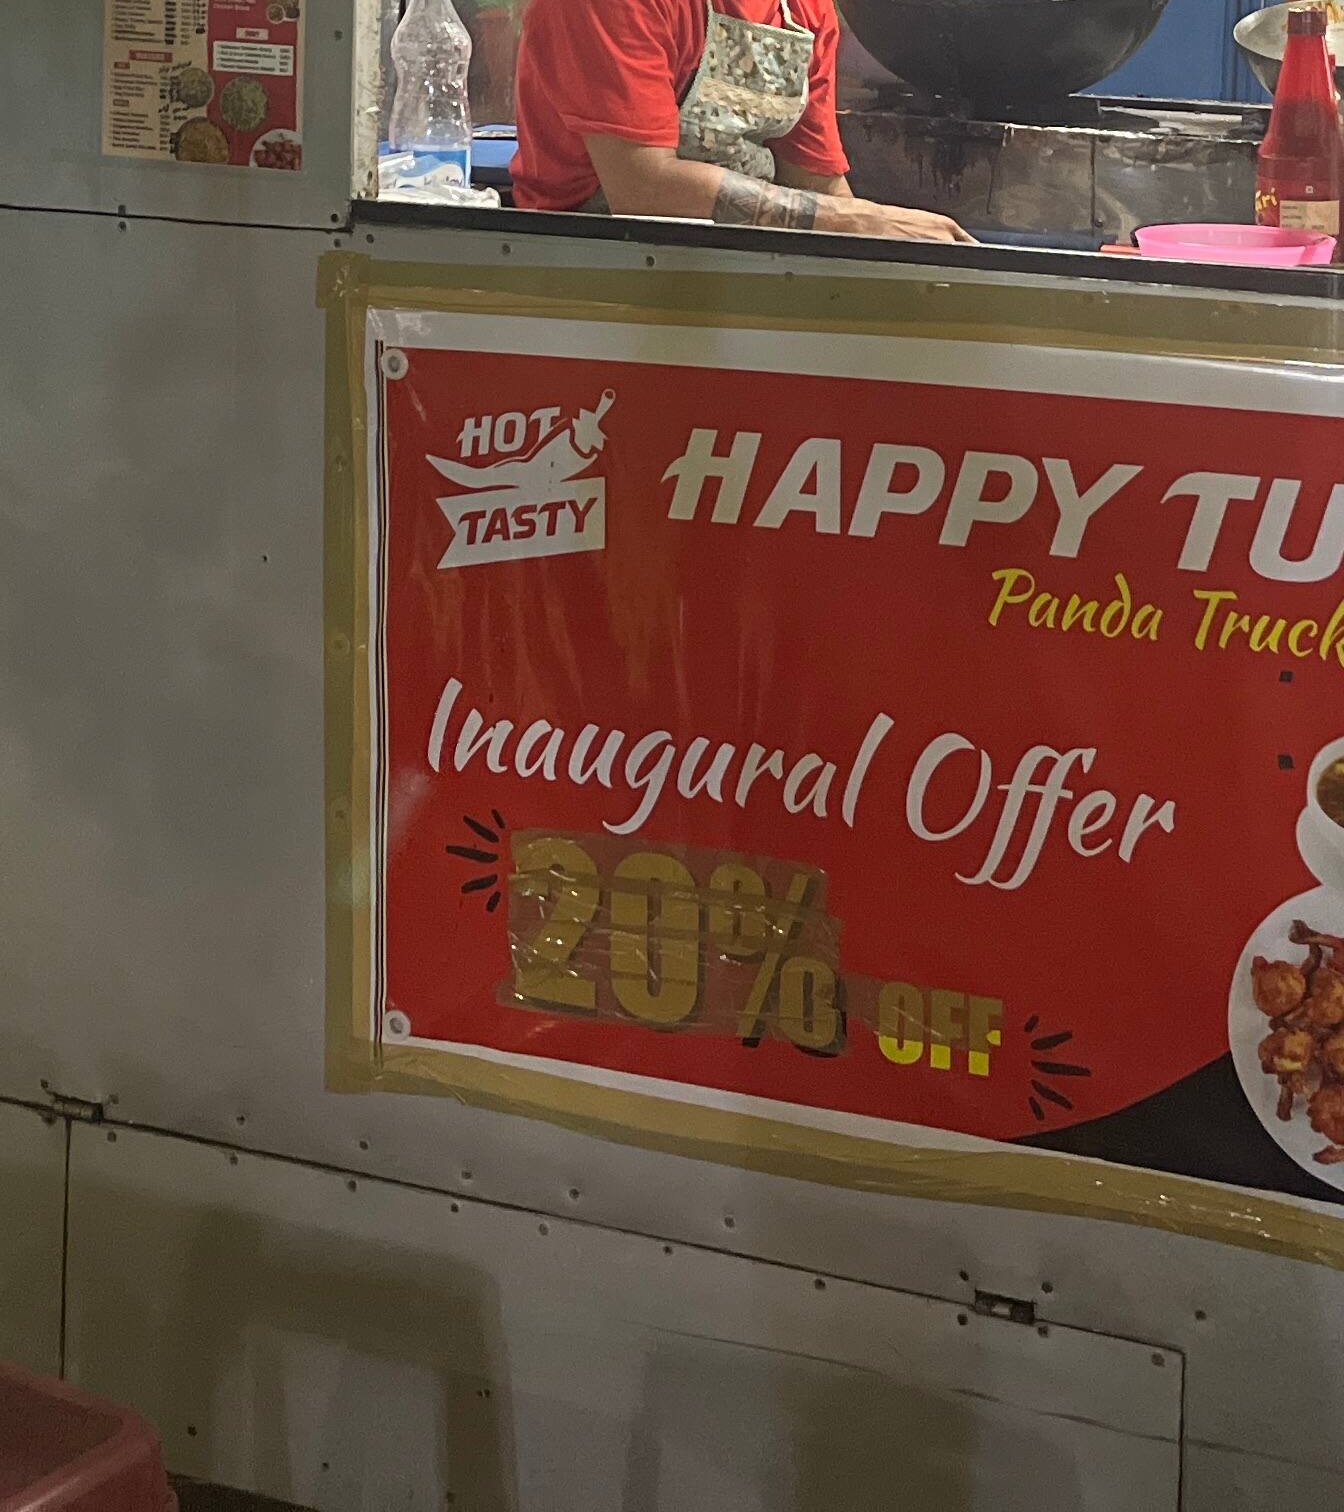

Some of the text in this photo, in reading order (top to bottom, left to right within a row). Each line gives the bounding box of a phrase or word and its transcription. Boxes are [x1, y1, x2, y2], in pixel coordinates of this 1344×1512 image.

[457, 406, 562, 458] HOT
[458, 496, 598, 546] TASTY
[661, 428, 1144, 559] HAPPY
[987, 567, 1162, 644] Panda
[425, 676, 1177, 891] Inaugural Offer
[509, 834, 1005, 1078] 20% OFF
